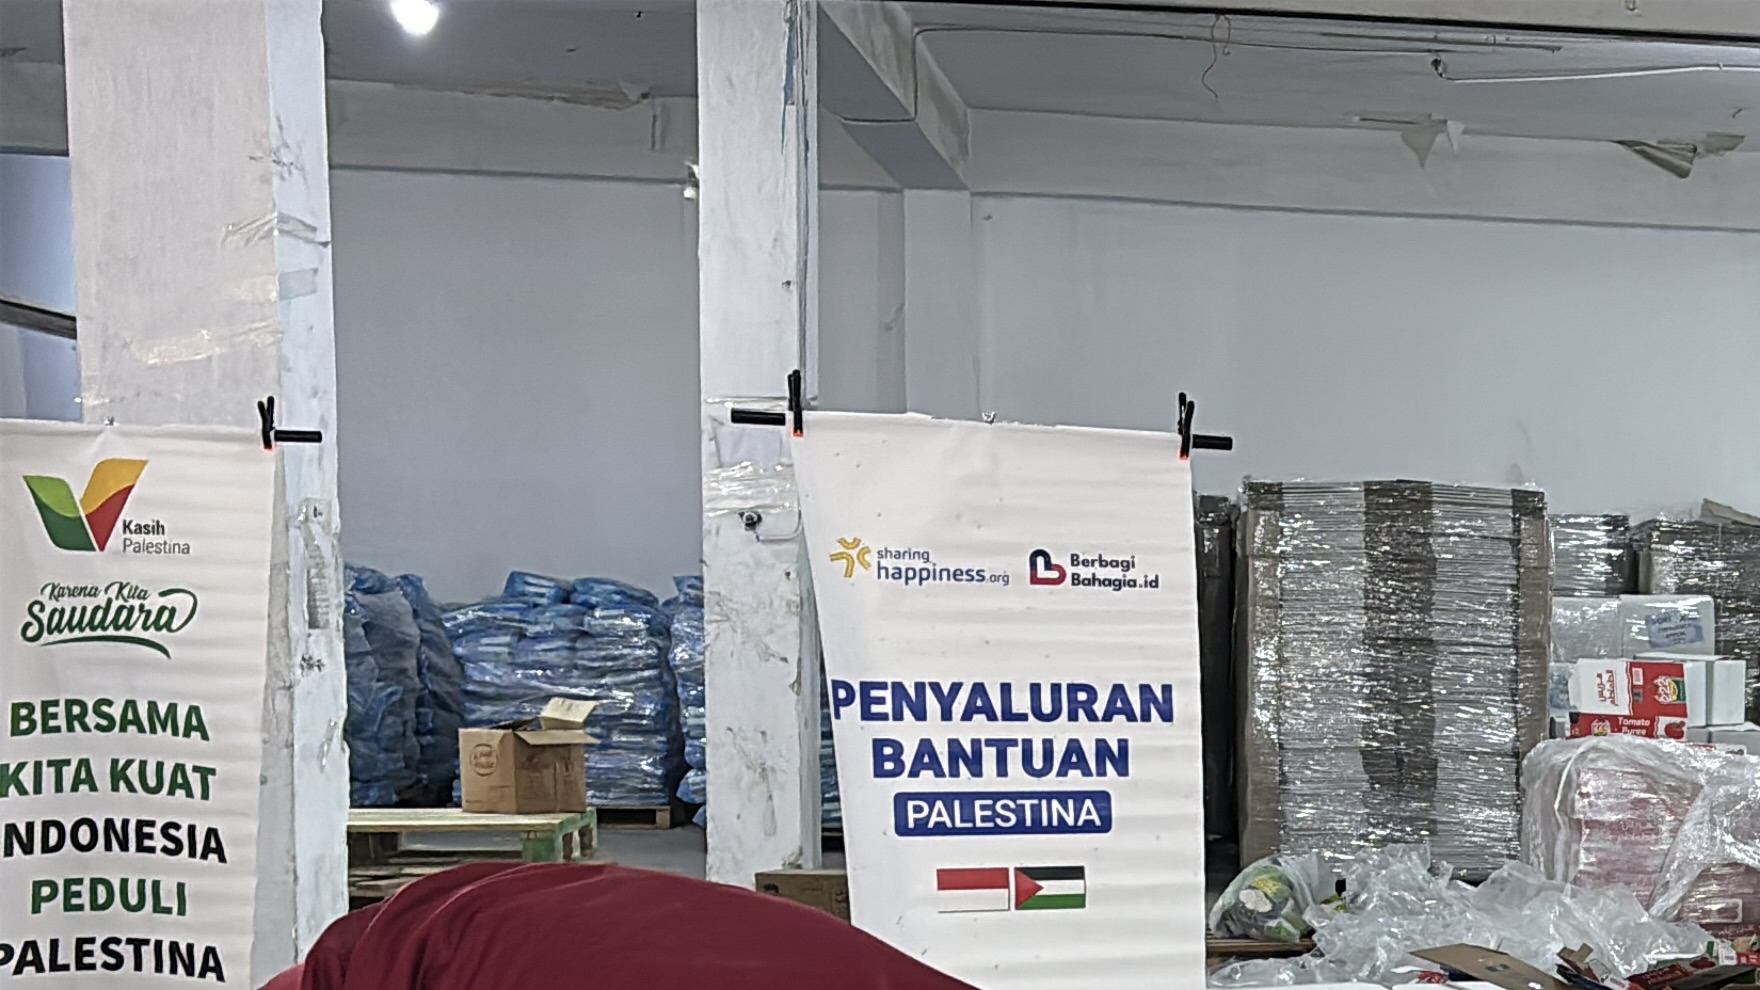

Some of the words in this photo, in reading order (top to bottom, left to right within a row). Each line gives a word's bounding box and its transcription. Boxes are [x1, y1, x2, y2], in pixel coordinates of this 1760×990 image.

[122, 519, 165, 536] Kasih
[122, 537, 191, 555] Palestina
[877, 547, 930, 564] sharing
[877, 560, 1010, 586] happiness.org
[1070, 553, 1136, 572] Berbagi
[40, 582, 101, 602] Karena
[104, 581, 150, 602] Kita
[1071, 572, 1159, 592] Bahagia.id
[20, 588, 198, 643] Saudara
[831, 678, 1175, 724] PENYALURAN
[9, 697, 211, 742] BERSAMA
[1618, 716, 1651, 727] Tomato
[872, 737, 1131, 779] BANTUAN
[0, 757, 99, 799] KITA
[109, 757, 217, 801] KUAT
[906, 798, 1102, 830] PALESTINA
[2, 816, 229, 865] NDONESIA
[30, 876, 187, 917] PEDULI
